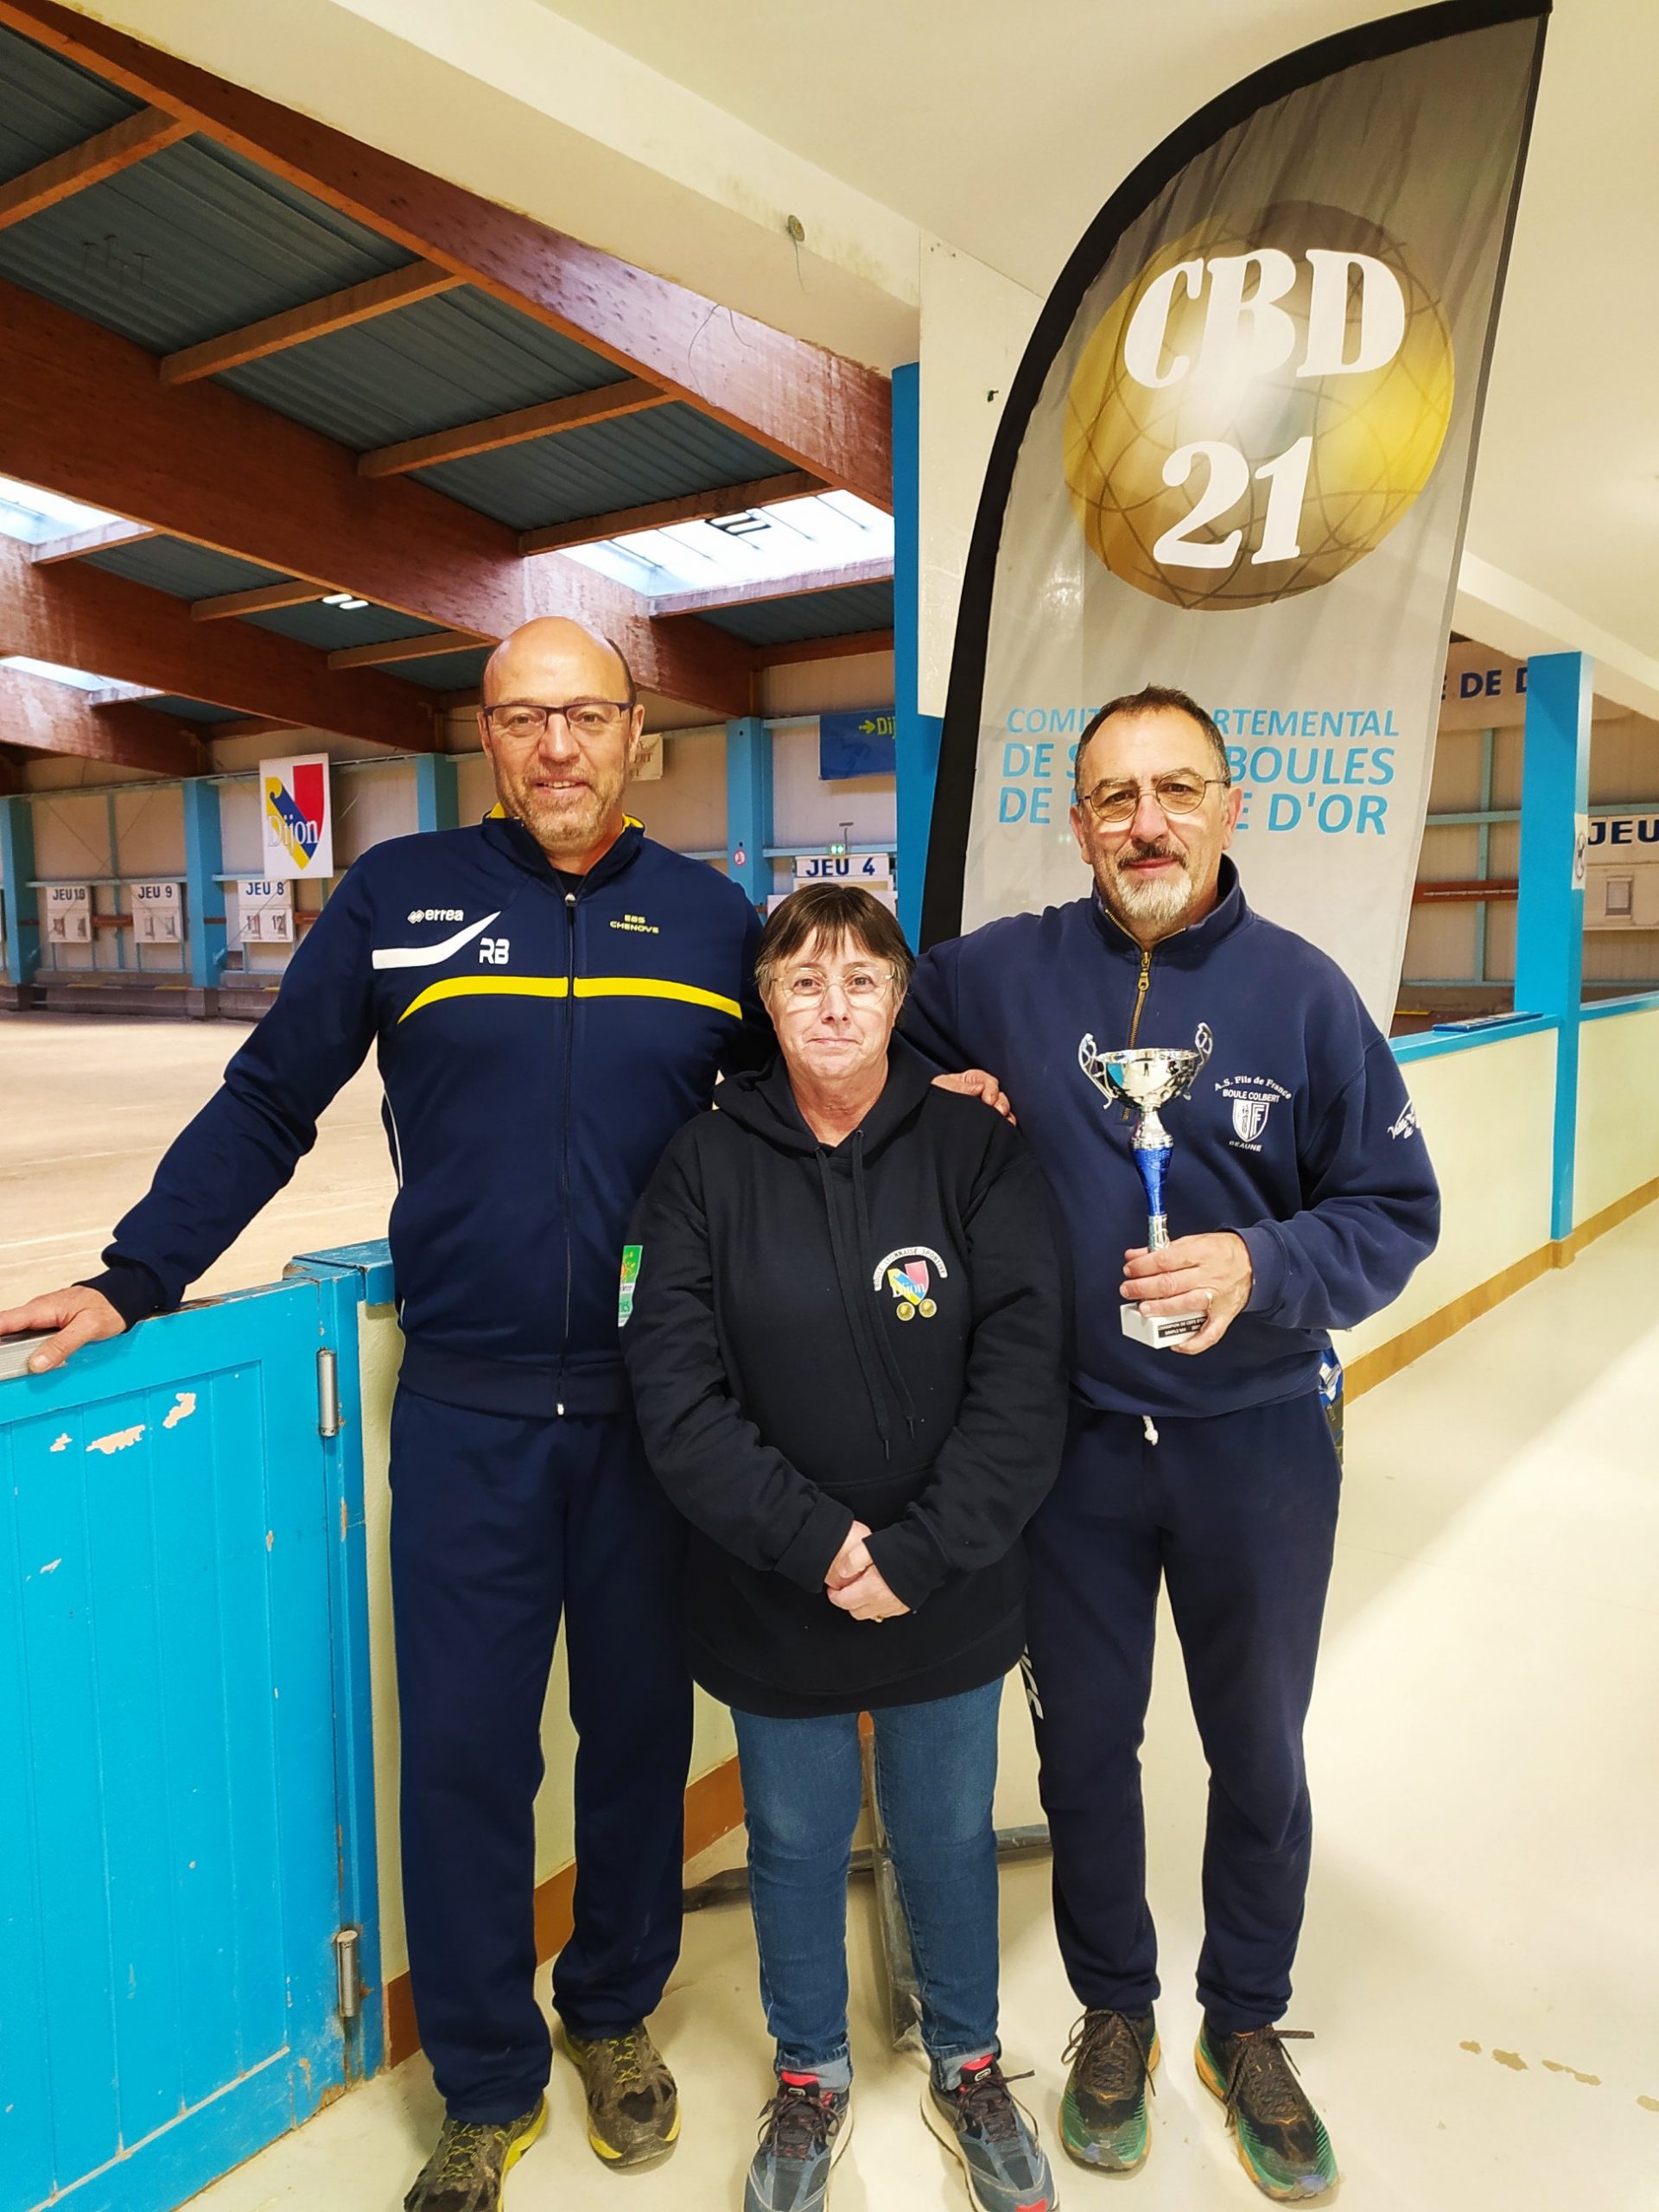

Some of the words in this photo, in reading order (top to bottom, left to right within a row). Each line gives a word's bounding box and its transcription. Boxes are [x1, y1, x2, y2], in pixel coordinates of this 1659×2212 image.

[1124, 248, 1405, 389] CBD
[1153, 436, 1313, 569] 21
[1460, 670, 1502, 699] DE
[1002, 743, 1054, 778] DE
[1225, 746, 1395, 785] BOULES
[999, 786, 1052, 824] DE
[1268, 791, 1388, 835] D'OR
[267, 814, 319, 856] Dijon
[1587, 819, 1659, 845] JEU
[805, 858, 849, 876] JEU
[862, 857, 875, 875] 4
[53, 889, 73, 900] JEU
[138, 887, 161, 899] JEU
[165, 886, 173, 898] 9
[245, 881, 270, 895] JEU
[276, 881, 284, 895] 8
[425, 909, 464, 922] errea
[479, 937, 510, 965] RB
[1222, 1089, 1248, 1099] BOULE
[1248, 1091, 1281, 1103] COLBERT
[1253, 1077, 1265, 1085] de
[1265, 1079, 1292, 1099] France
[1229, 1141, 1262, 1152] BEAUNE
